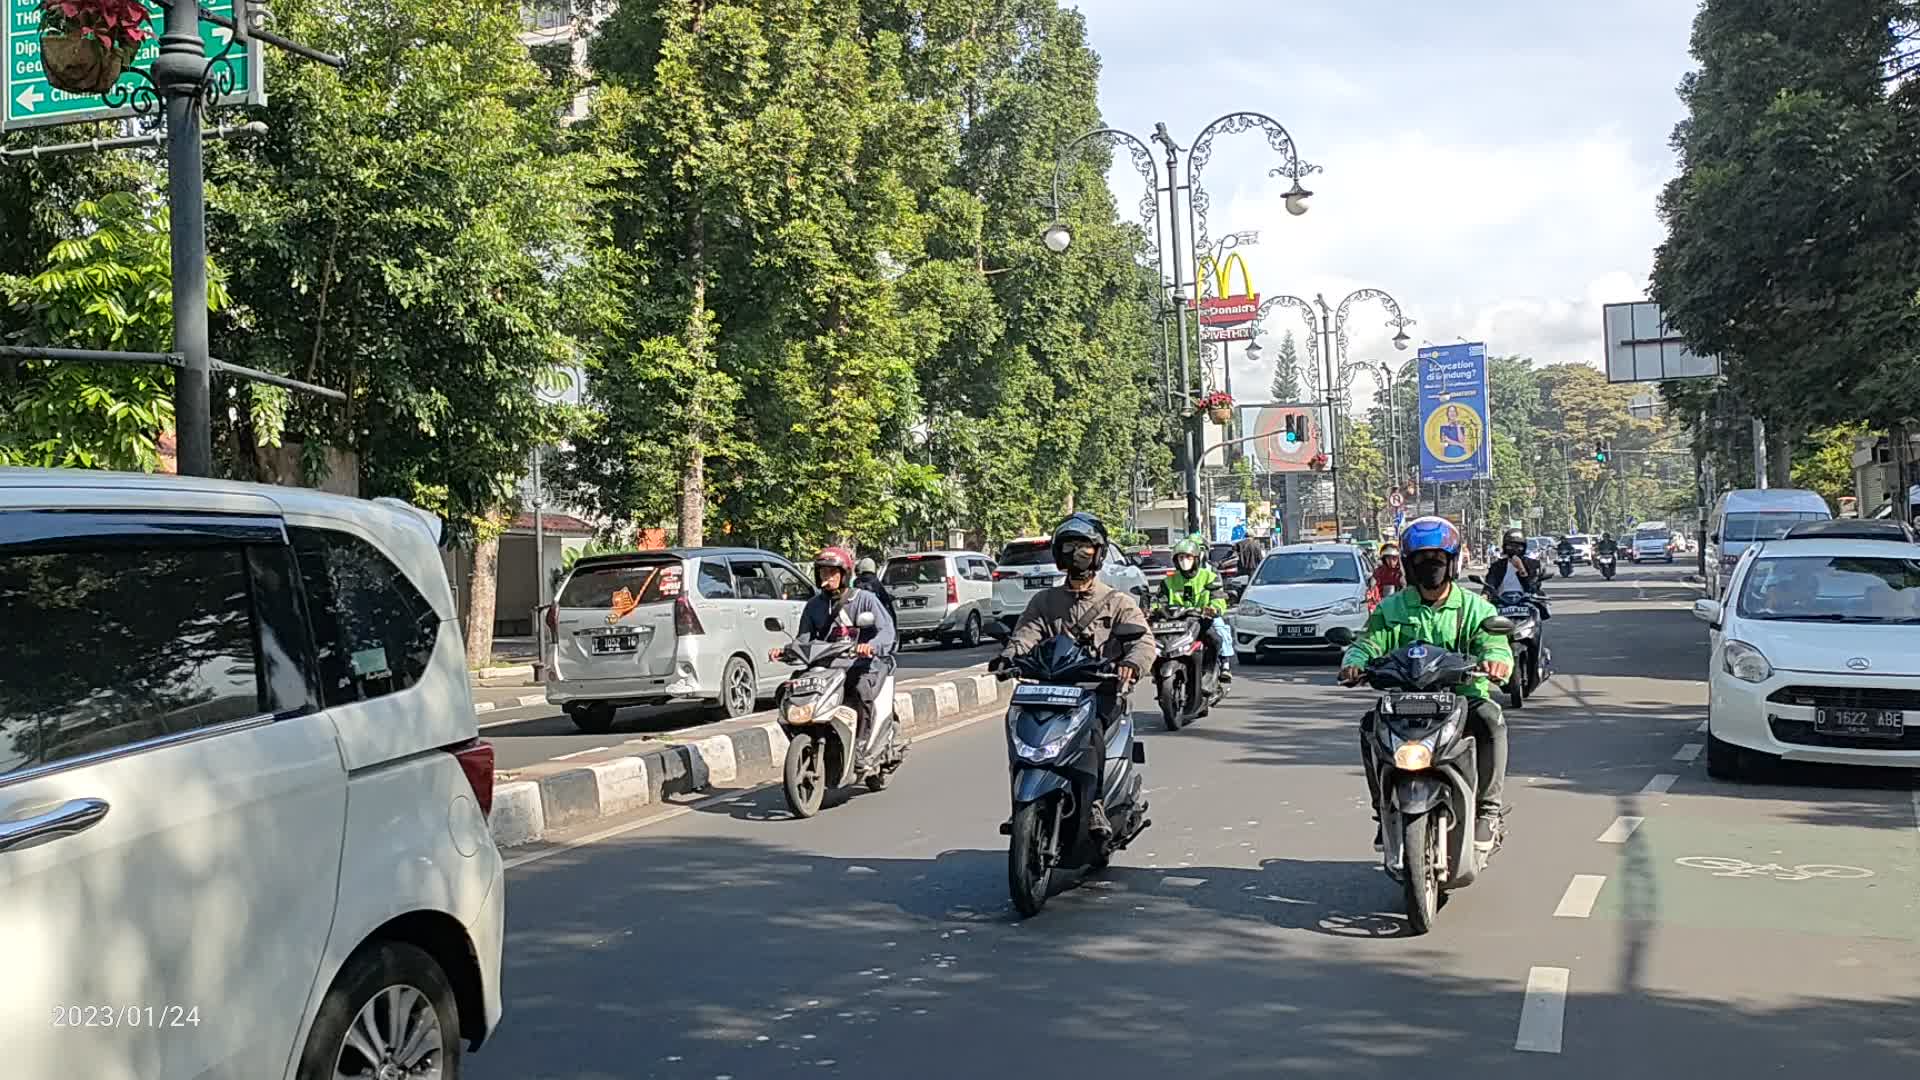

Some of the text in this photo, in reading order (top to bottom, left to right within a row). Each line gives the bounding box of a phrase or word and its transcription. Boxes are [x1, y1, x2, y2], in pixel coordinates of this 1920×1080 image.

[15, 40, 41, 56] Dip
[15, 60, 43, 75] Ged
[1878, 711, 1902, 728] ABE
